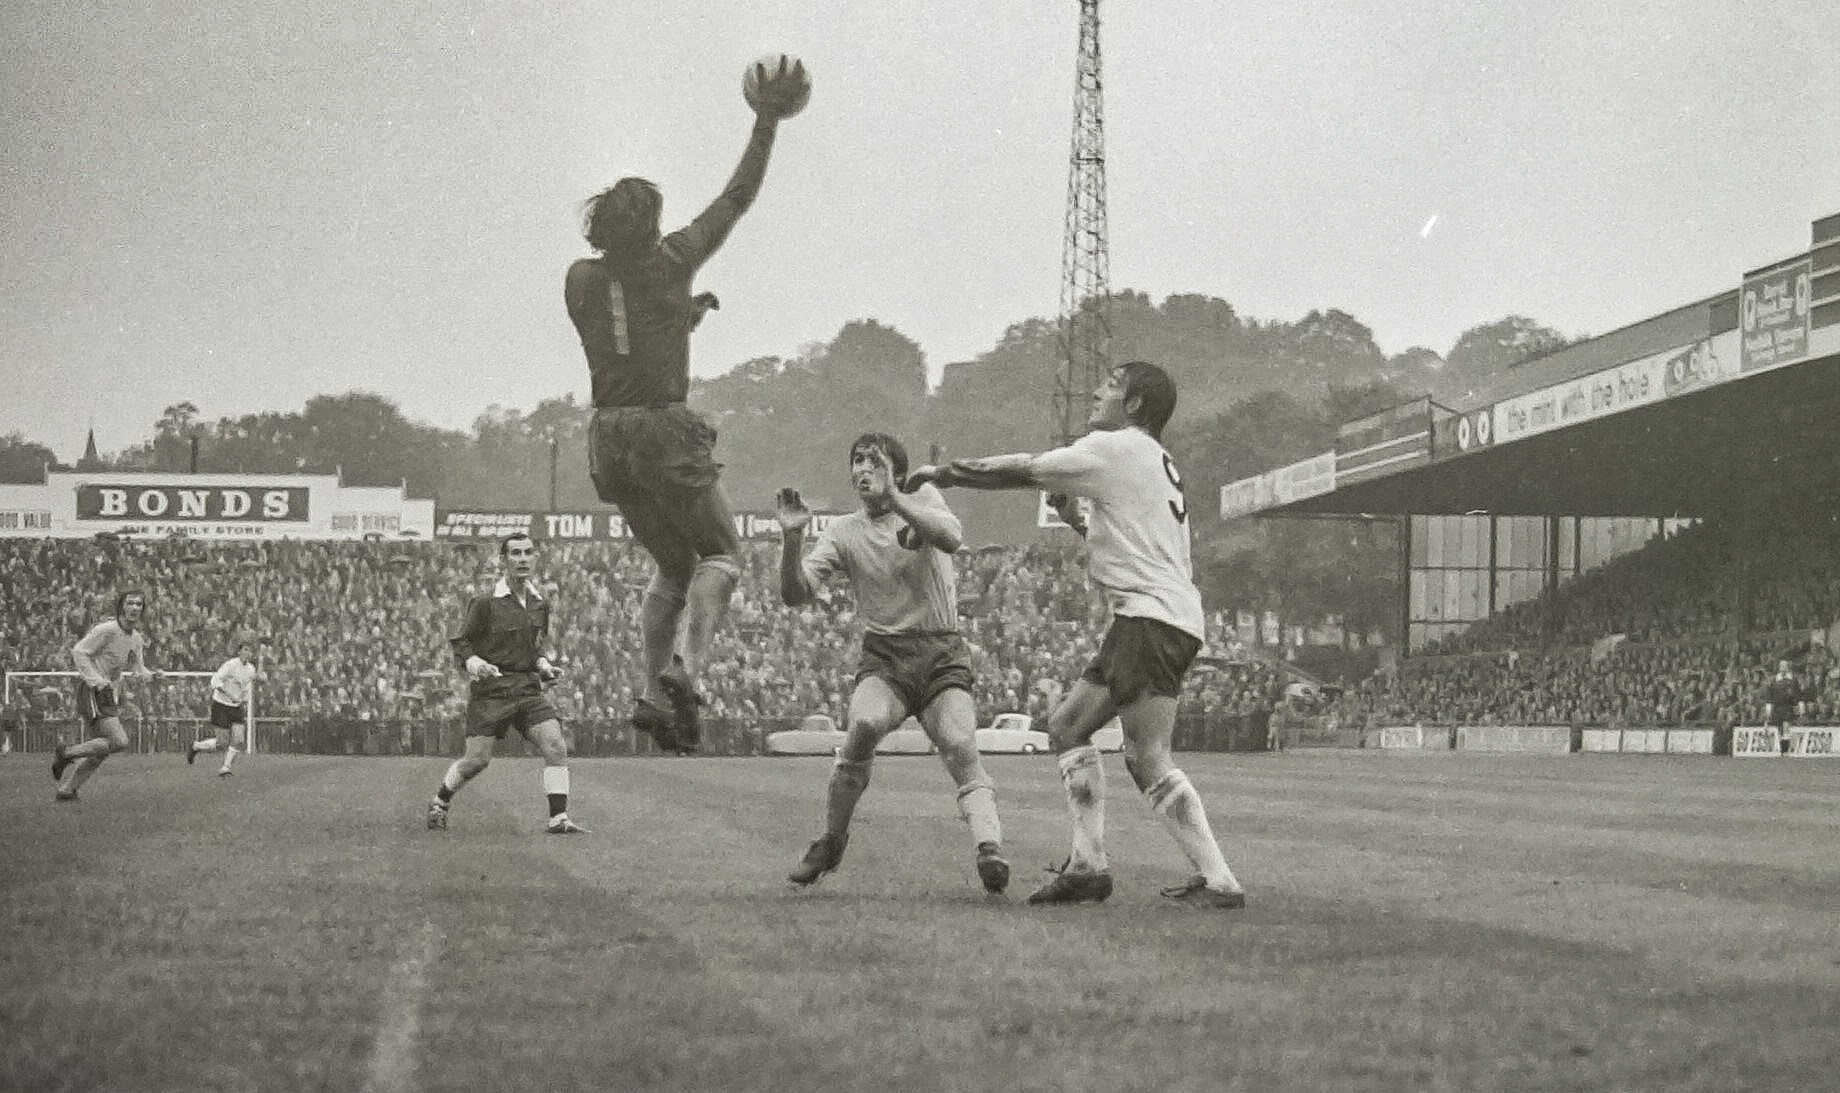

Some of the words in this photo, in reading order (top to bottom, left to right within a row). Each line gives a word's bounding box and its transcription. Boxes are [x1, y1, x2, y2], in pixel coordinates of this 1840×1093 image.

[609, 281, 630, 355] 1
[99, 488, 290, 518] BONDS
[1162, 452, 1189, 525] 9
[215, 525, 265, 535] STORE
[544, 513, 594, 538] TOM
